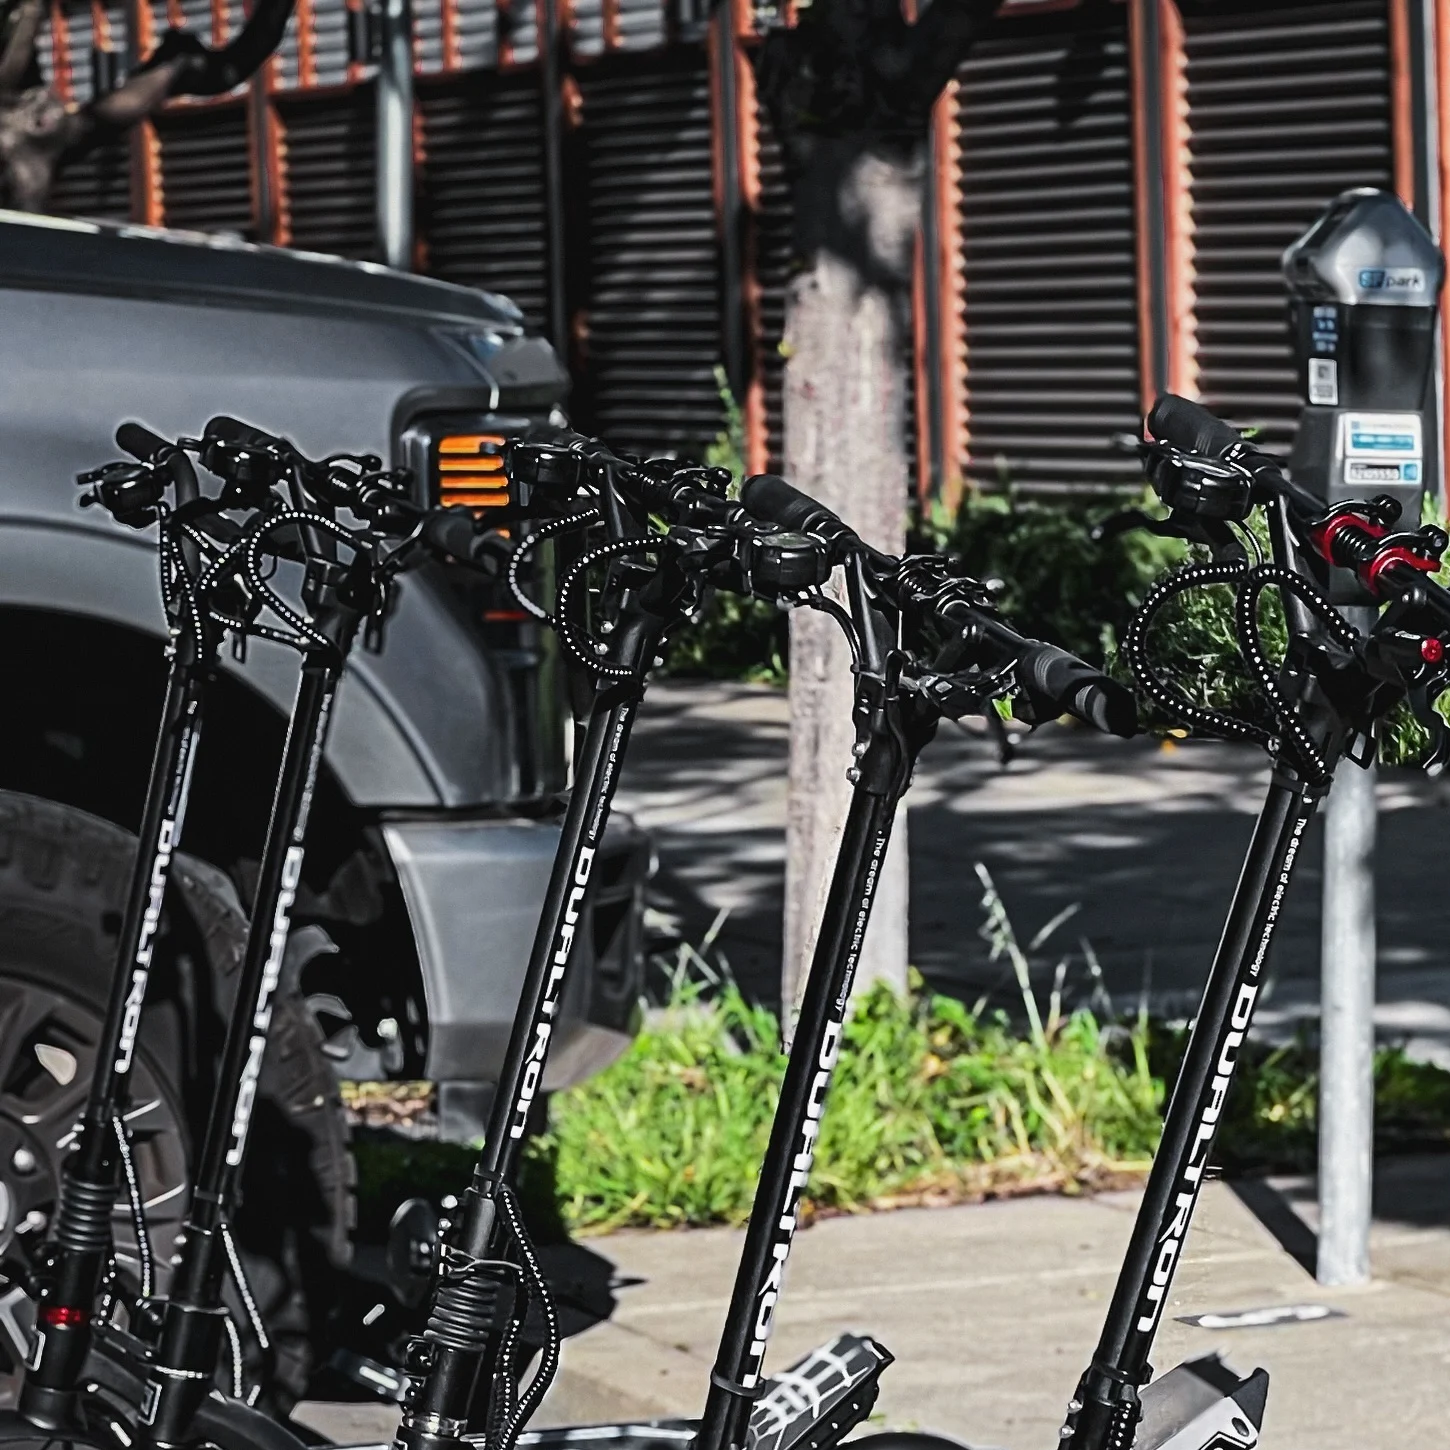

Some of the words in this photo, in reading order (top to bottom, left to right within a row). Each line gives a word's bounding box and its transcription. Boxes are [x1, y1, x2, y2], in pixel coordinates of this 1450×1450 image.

[1283, 837, 1299, 871] dream
[1294, 818, 1307, 835] The
[510, 846, 595, 1140] DUALTRON
[742, 1019, 842, 1388] DUALTRON
[1137, 983, 1258, 1333] DUALTRON
